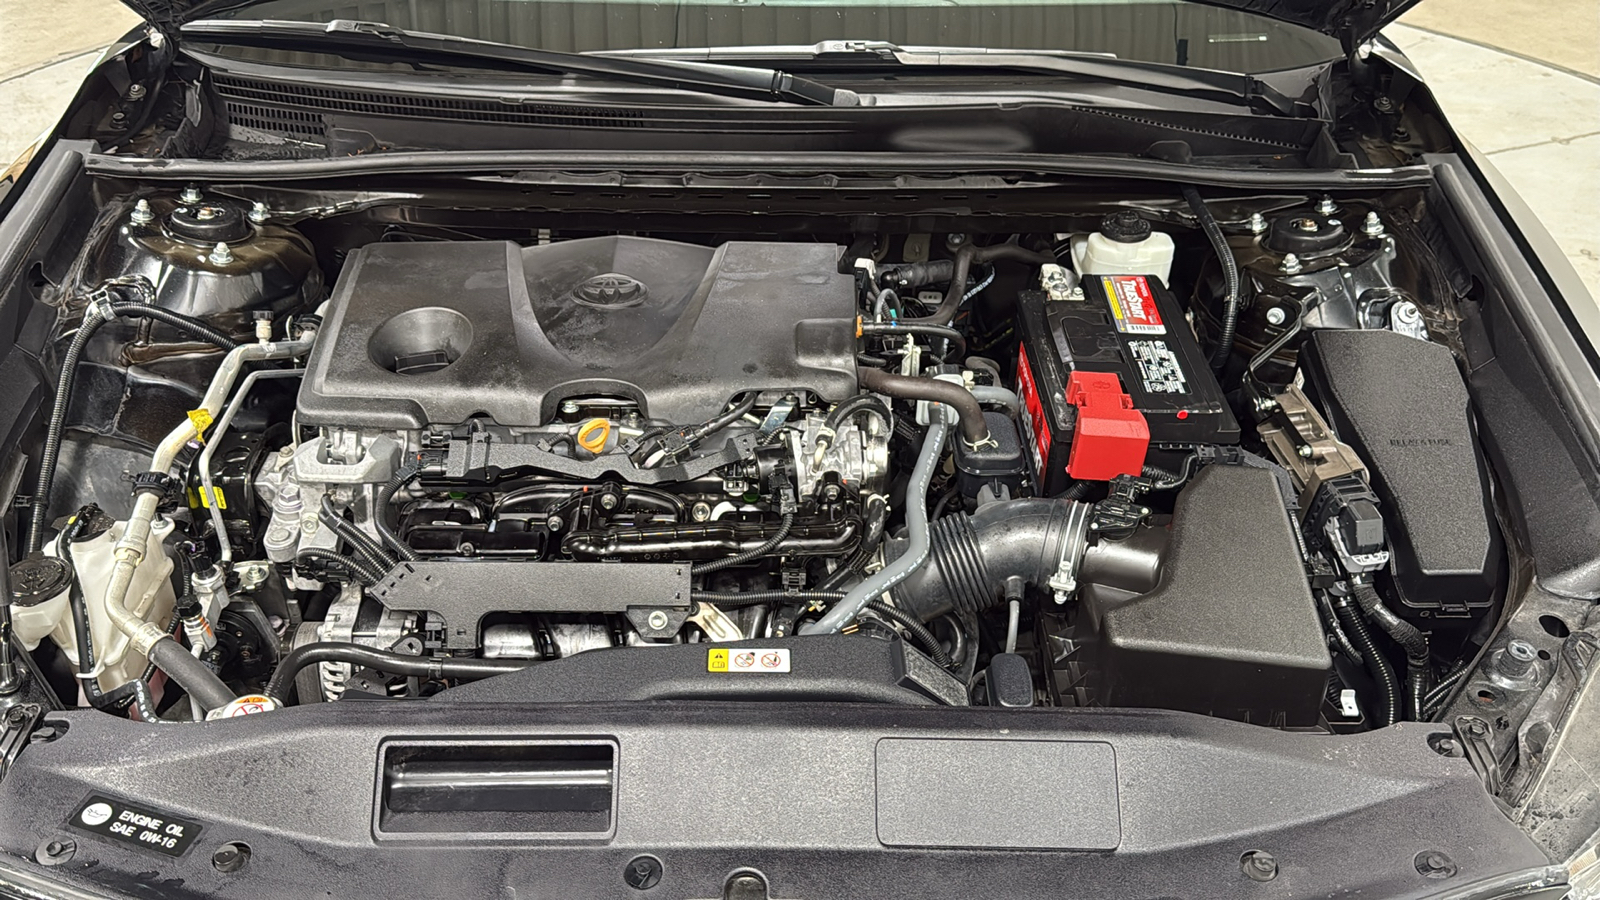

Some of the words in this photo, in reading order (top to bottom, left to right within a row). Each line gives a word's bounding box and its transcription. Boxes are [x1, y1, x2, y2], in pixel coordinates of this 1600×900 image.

[109, 822, 136, 837] SAE
[139, 831, 177, 848] 0W-16
[118, 810, 163, 830] ENGINE
[165, 824, 184, 837] OIL
